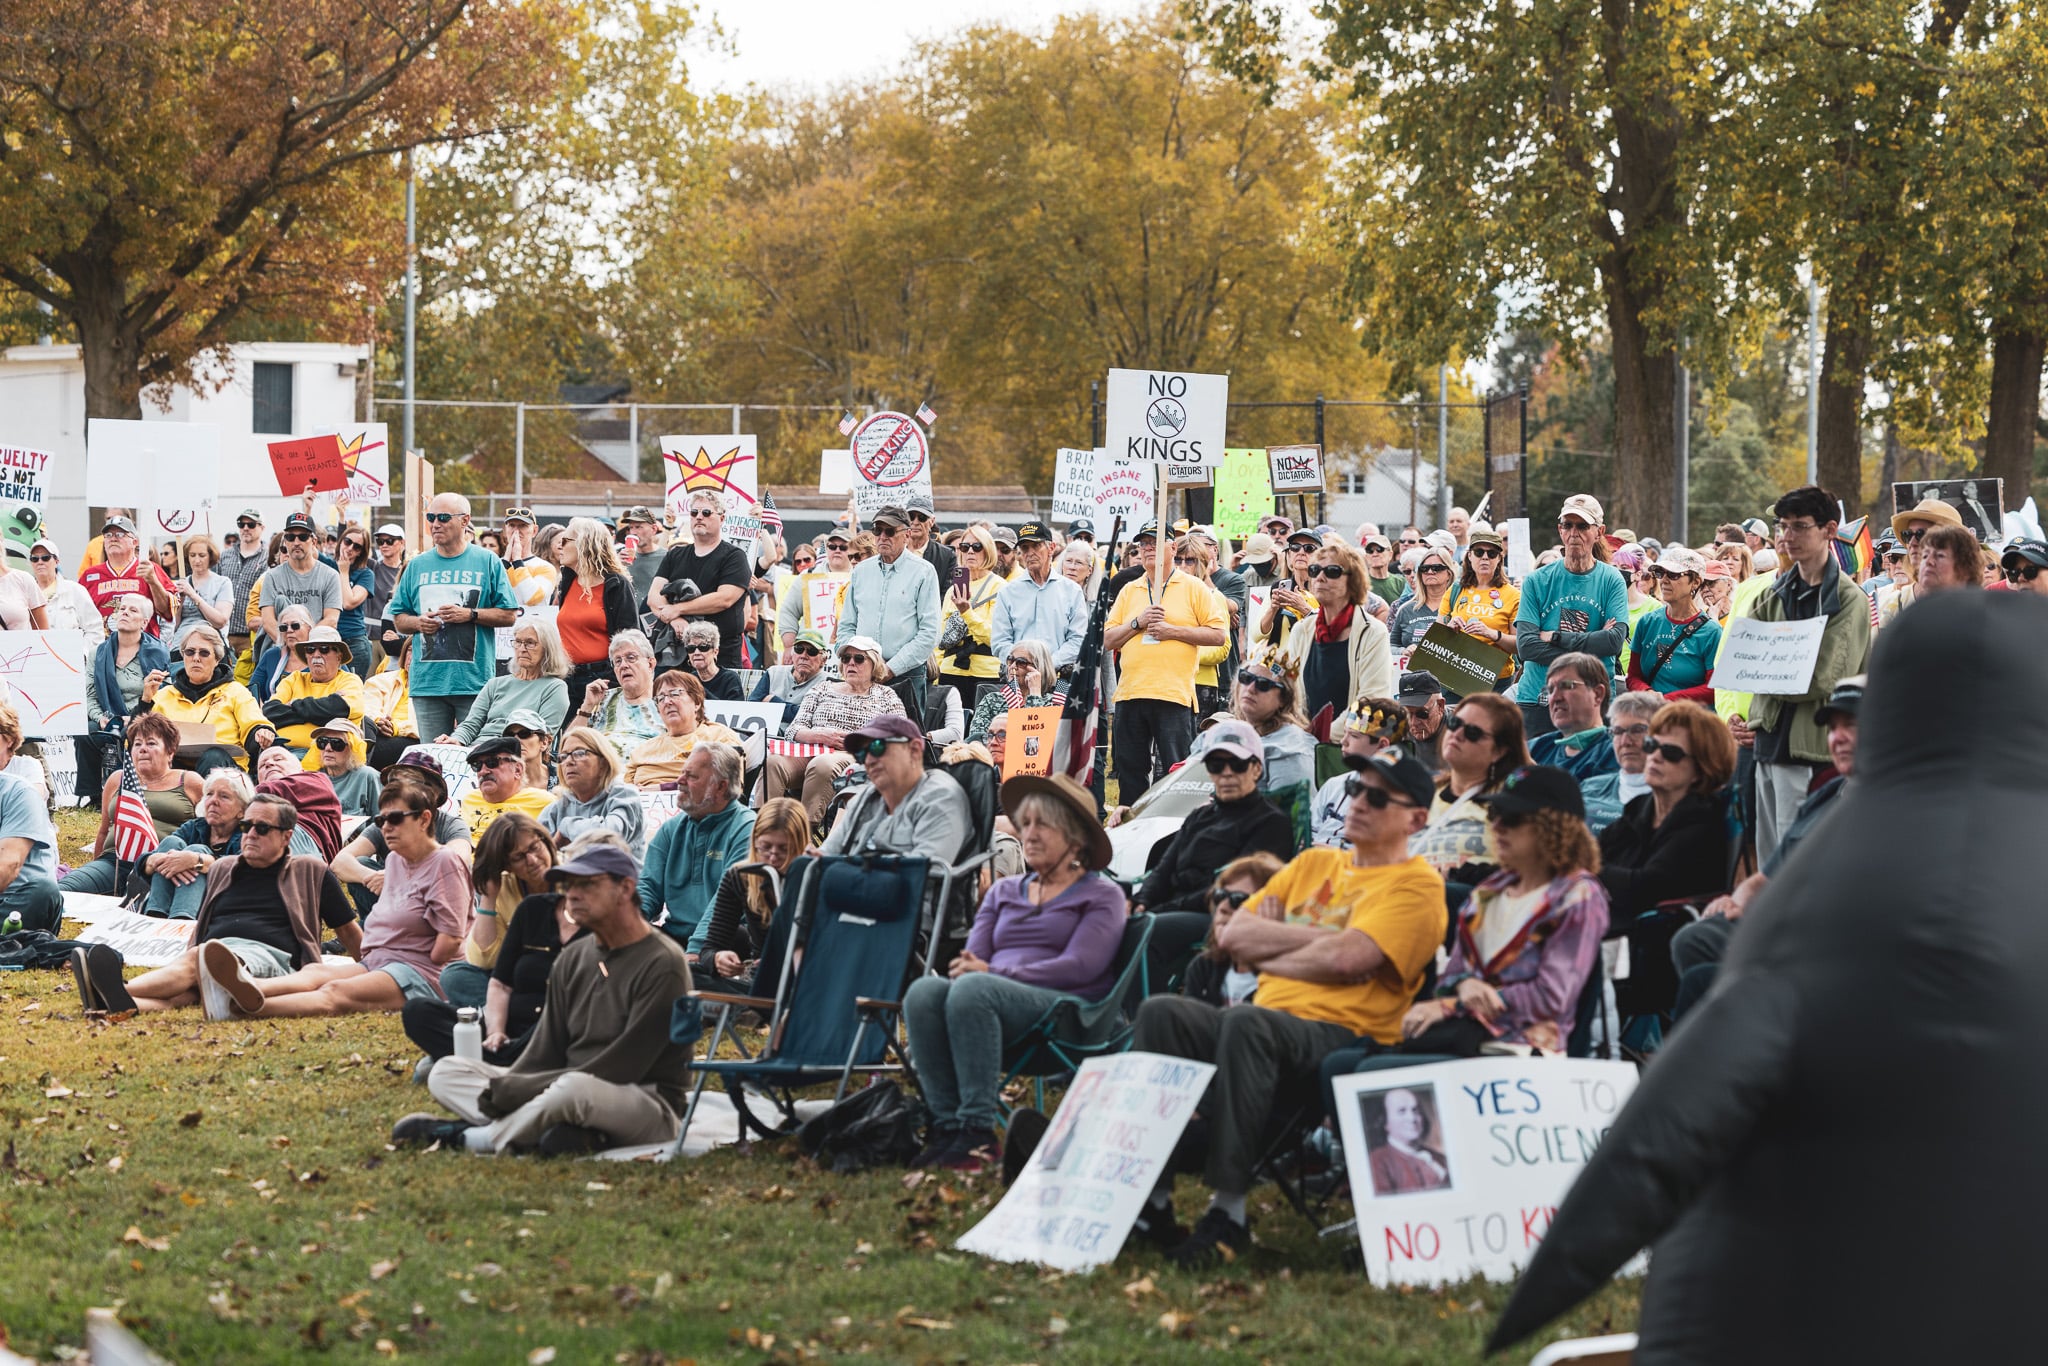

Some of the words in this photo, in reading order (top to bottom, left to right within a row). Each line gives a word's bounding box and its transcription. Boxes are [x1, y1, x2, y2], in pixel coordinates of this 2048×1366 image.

[1148, 374, 1187, 398] NO
[1127, 436, 1203, 463] KINGS
[0, 449, 48, 471] UELTY
[286, 459, 338, 476] IMMIGRANTS
[1277, 456, 1292, 471] NO
[13, 469, 36, 486] NOT
[1101, 470, 1142, 486] INSANE
[1278, 469, 1316, 481] DICTATORS
[1058, 481, 1095, 498] CHEC
[1095, 486, 1152, 504] DICTATORS
[1053, 500, 1094, 518] BALANC
[420, 570, 484, 585] RESIST
[1466, 604, 1496, 617] LOVE
[1541, 595, 1587, 618] REJECTING
[1421, 639, 1454, 659] DANNY
[1460, 658, 1497, 682] CEISLER
[1022, 723, 1045, 731] KINGS
[108, 917, 155, 935] NO
[1463, 1078, 1541, 1115] YES
[1571, 1078, 1616, 1114] TO
[1384, 1222, 1440, 1262] NO
[1455, 1212, 1508, 1256] TO
